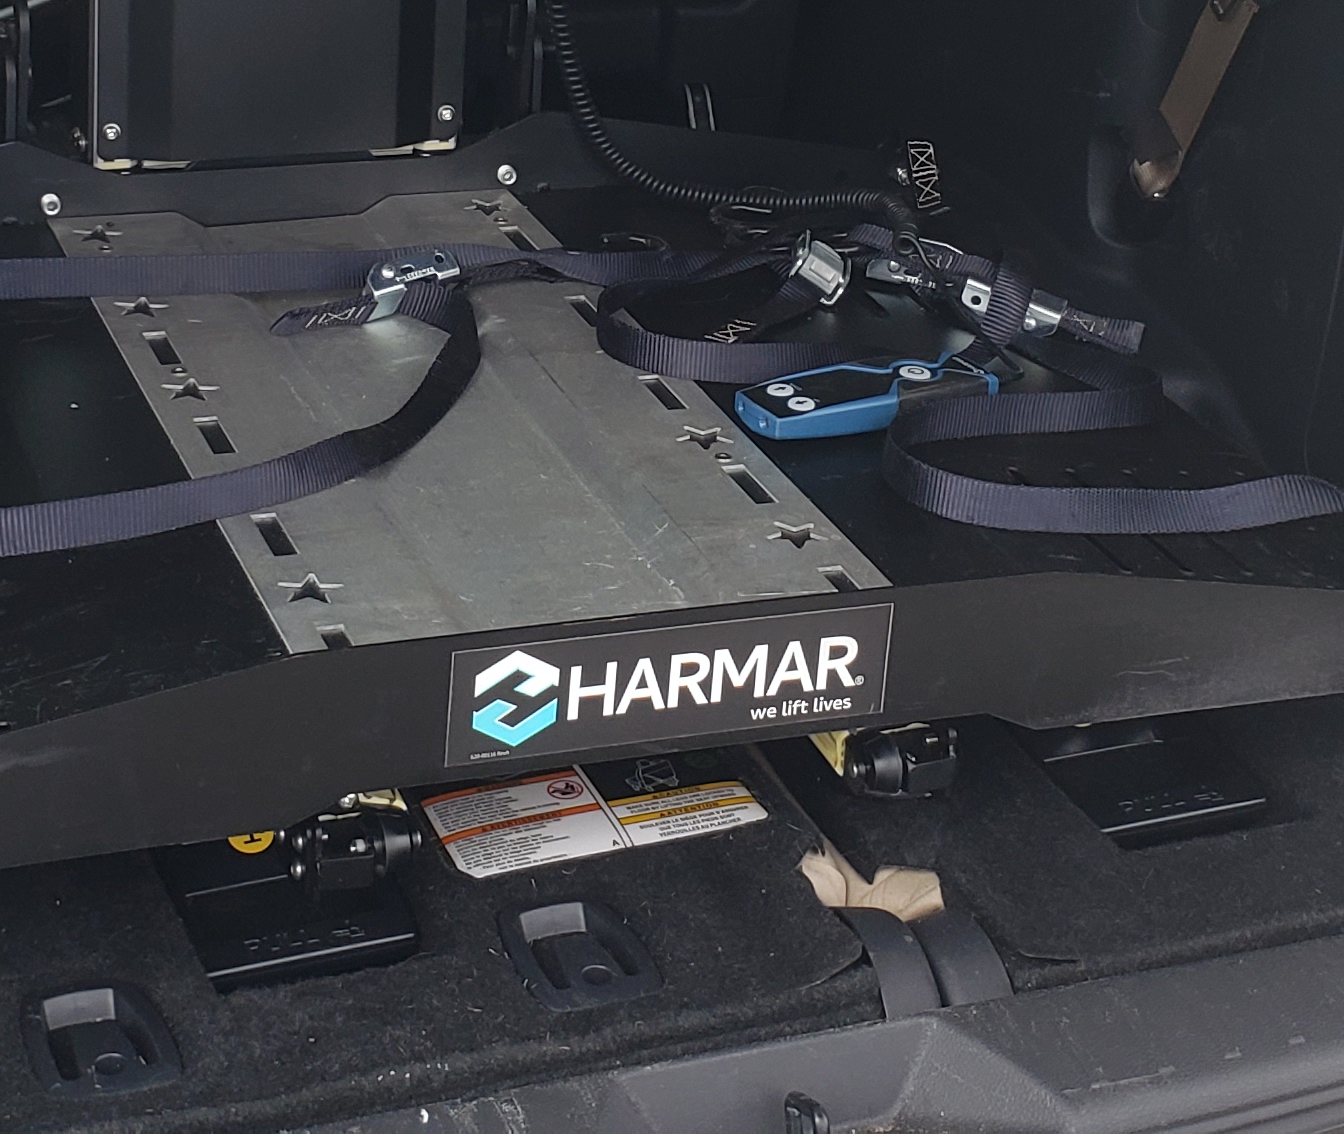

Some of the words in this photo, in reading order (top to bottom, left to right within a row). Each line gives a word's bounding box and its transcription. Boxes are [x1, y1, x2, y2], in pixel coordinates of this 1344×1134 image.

[567, 635, 860, 721] HARMAR
[750, 704, 777, 721] we
[781, 698, 809, 718] lift
[812, 695, 852, 715] lives
[612, 839, 620, 847] A
